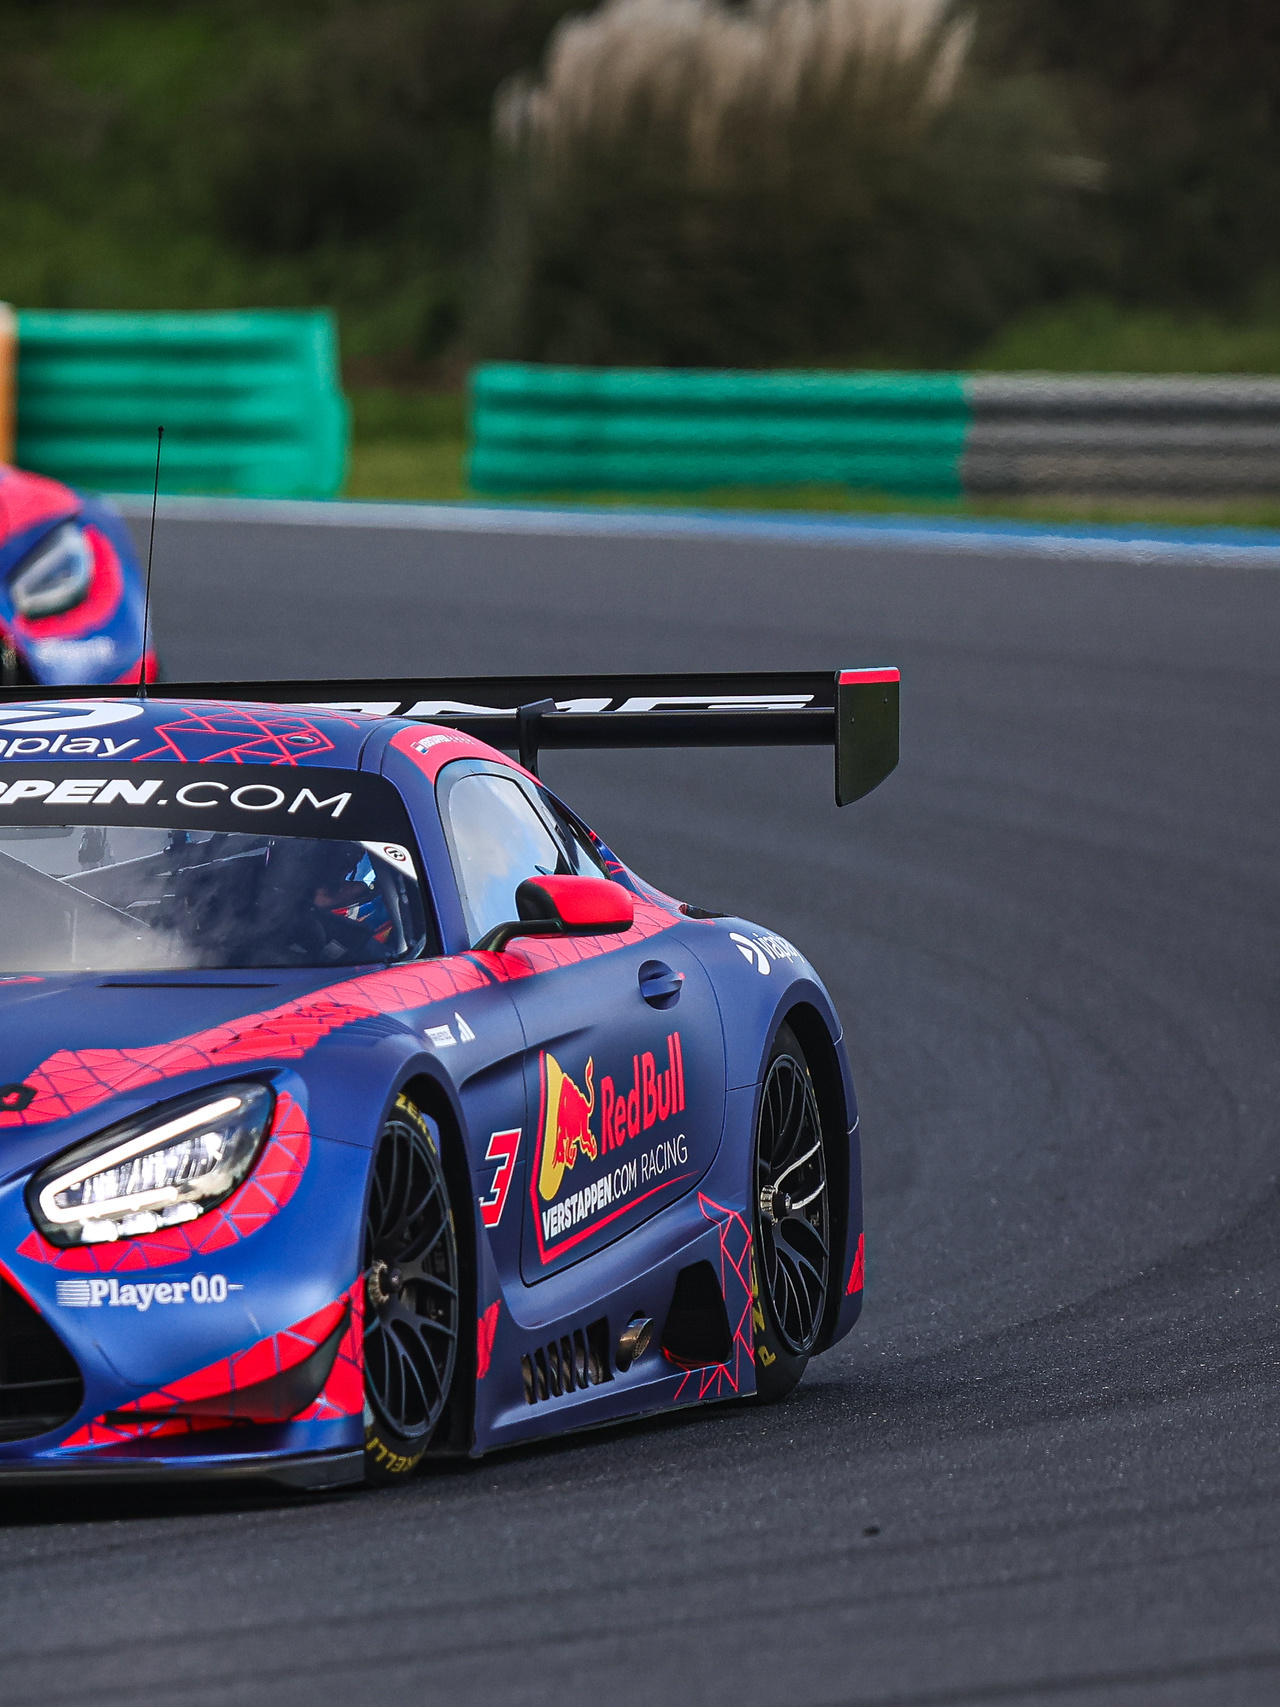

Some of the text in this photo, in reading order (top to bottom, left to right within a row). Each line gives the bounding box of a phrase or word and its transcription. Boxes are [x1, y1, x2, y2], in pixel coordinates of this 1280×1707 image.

[600, 1031, 686, 1156] Red Bull
[541, 1133, 689, 1242] VERSTAPPEN.COM RACING
[89, 1278, 190, 1312] Player
